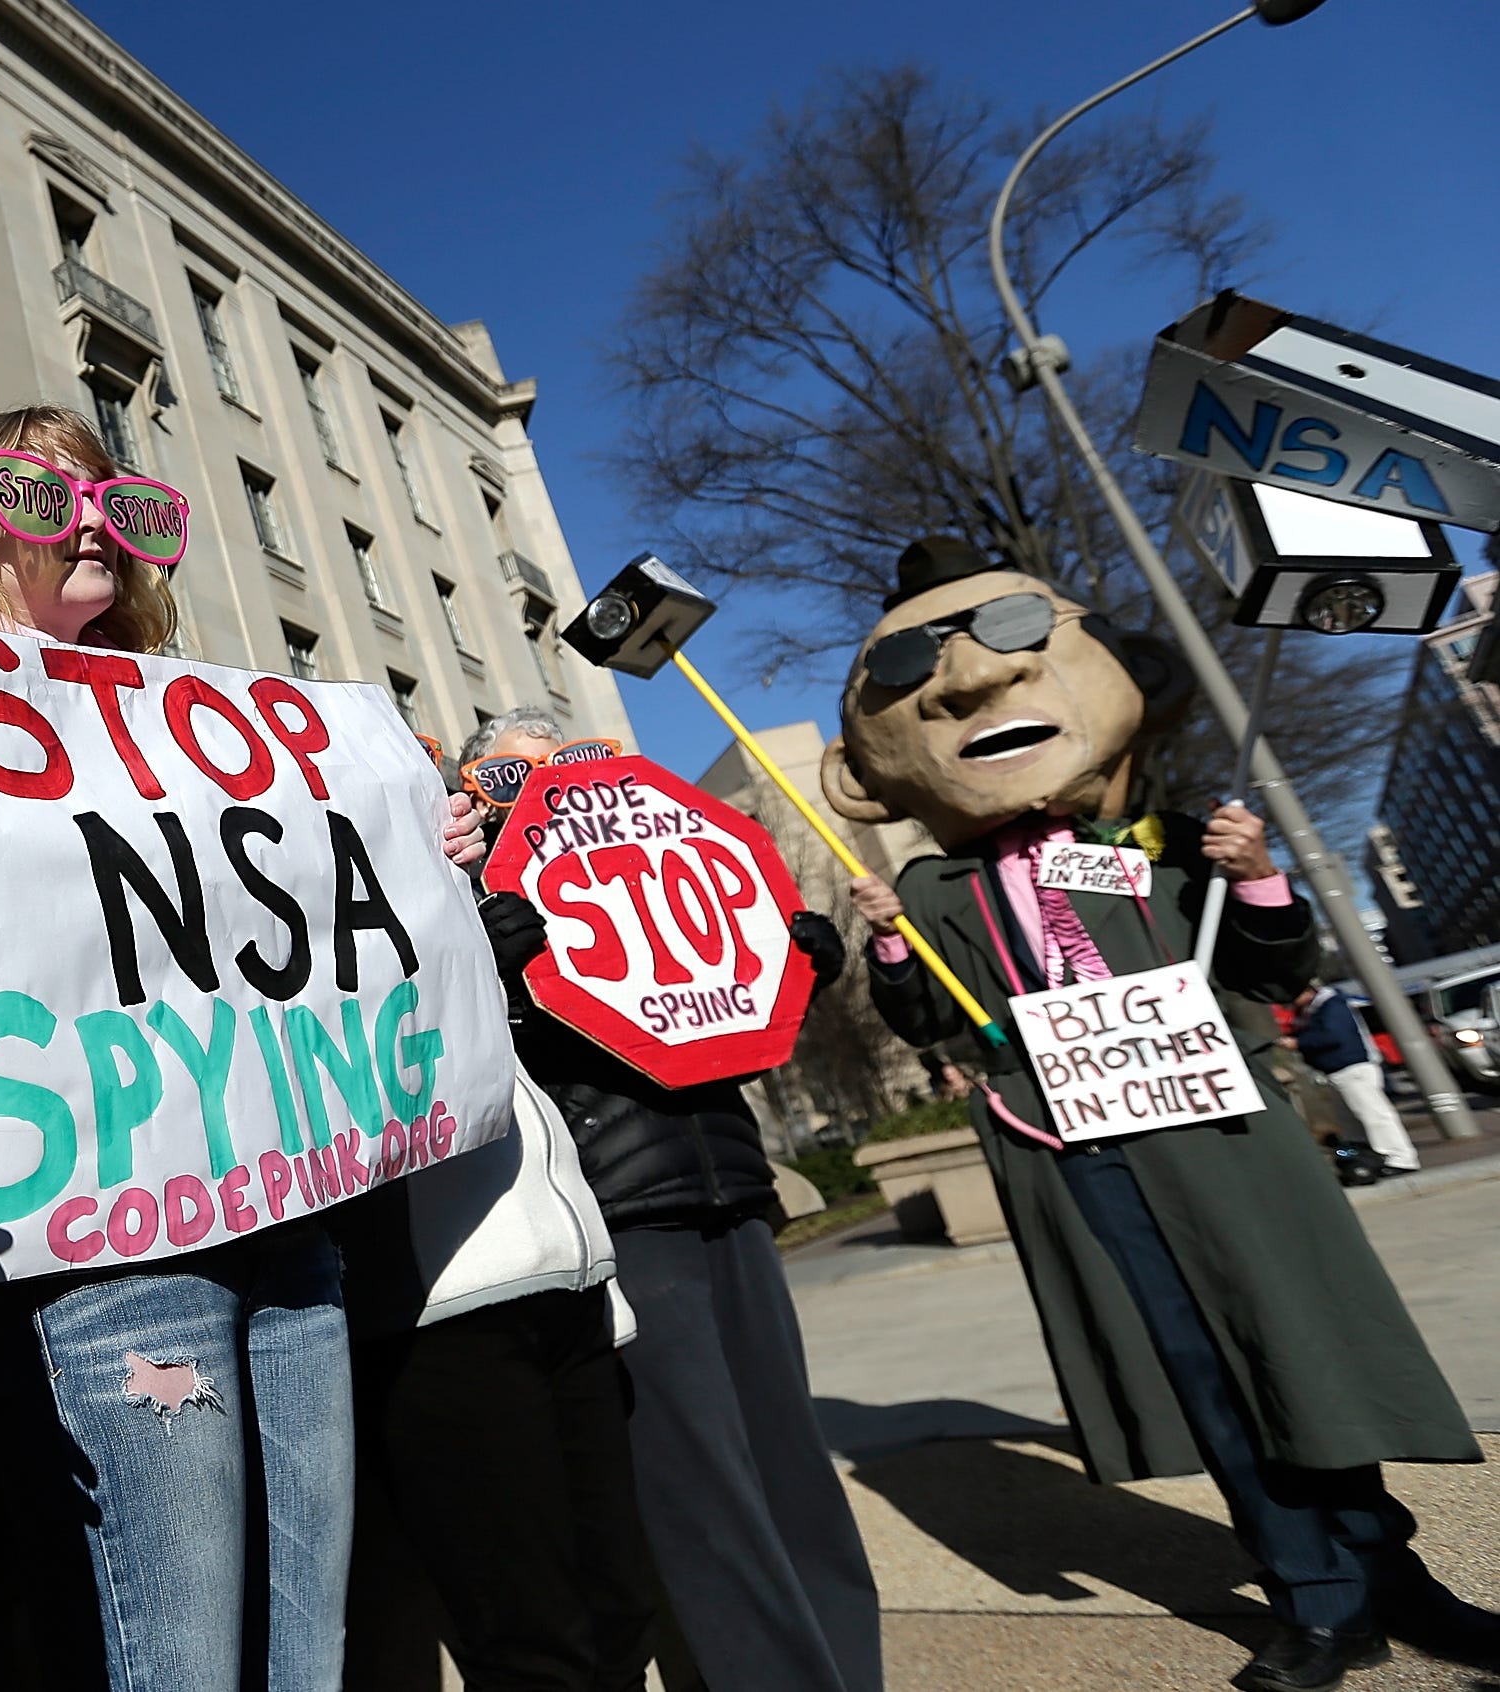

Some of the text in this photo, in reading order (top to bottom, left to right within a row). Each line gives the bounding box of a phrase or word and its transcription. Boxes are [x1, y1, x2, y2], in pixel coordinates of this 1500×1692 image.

[1180, 380, 1452, 516] NSA
[109, 493, 182, 537] SPYING
[477, 761, 529, 792] STOP
[544, 775, 645, 816] CODE
[523, 808, 708, 866] PINK SAYS
[72, 805, 420, 1007] NSA
[1043, 869, 1073, 885] IN
[538, 838, 762, 984] STOP
[639, 984, 758, 1034] SPYING
[1043, 985, 1167, 1042] BIG
[1036, 1020, 1229, 1091] BROTHER
[1052, 1067, 1236, 1133] IN-CHIEF
[46, 1100, 456, 1264] CODEPINK.ORG
